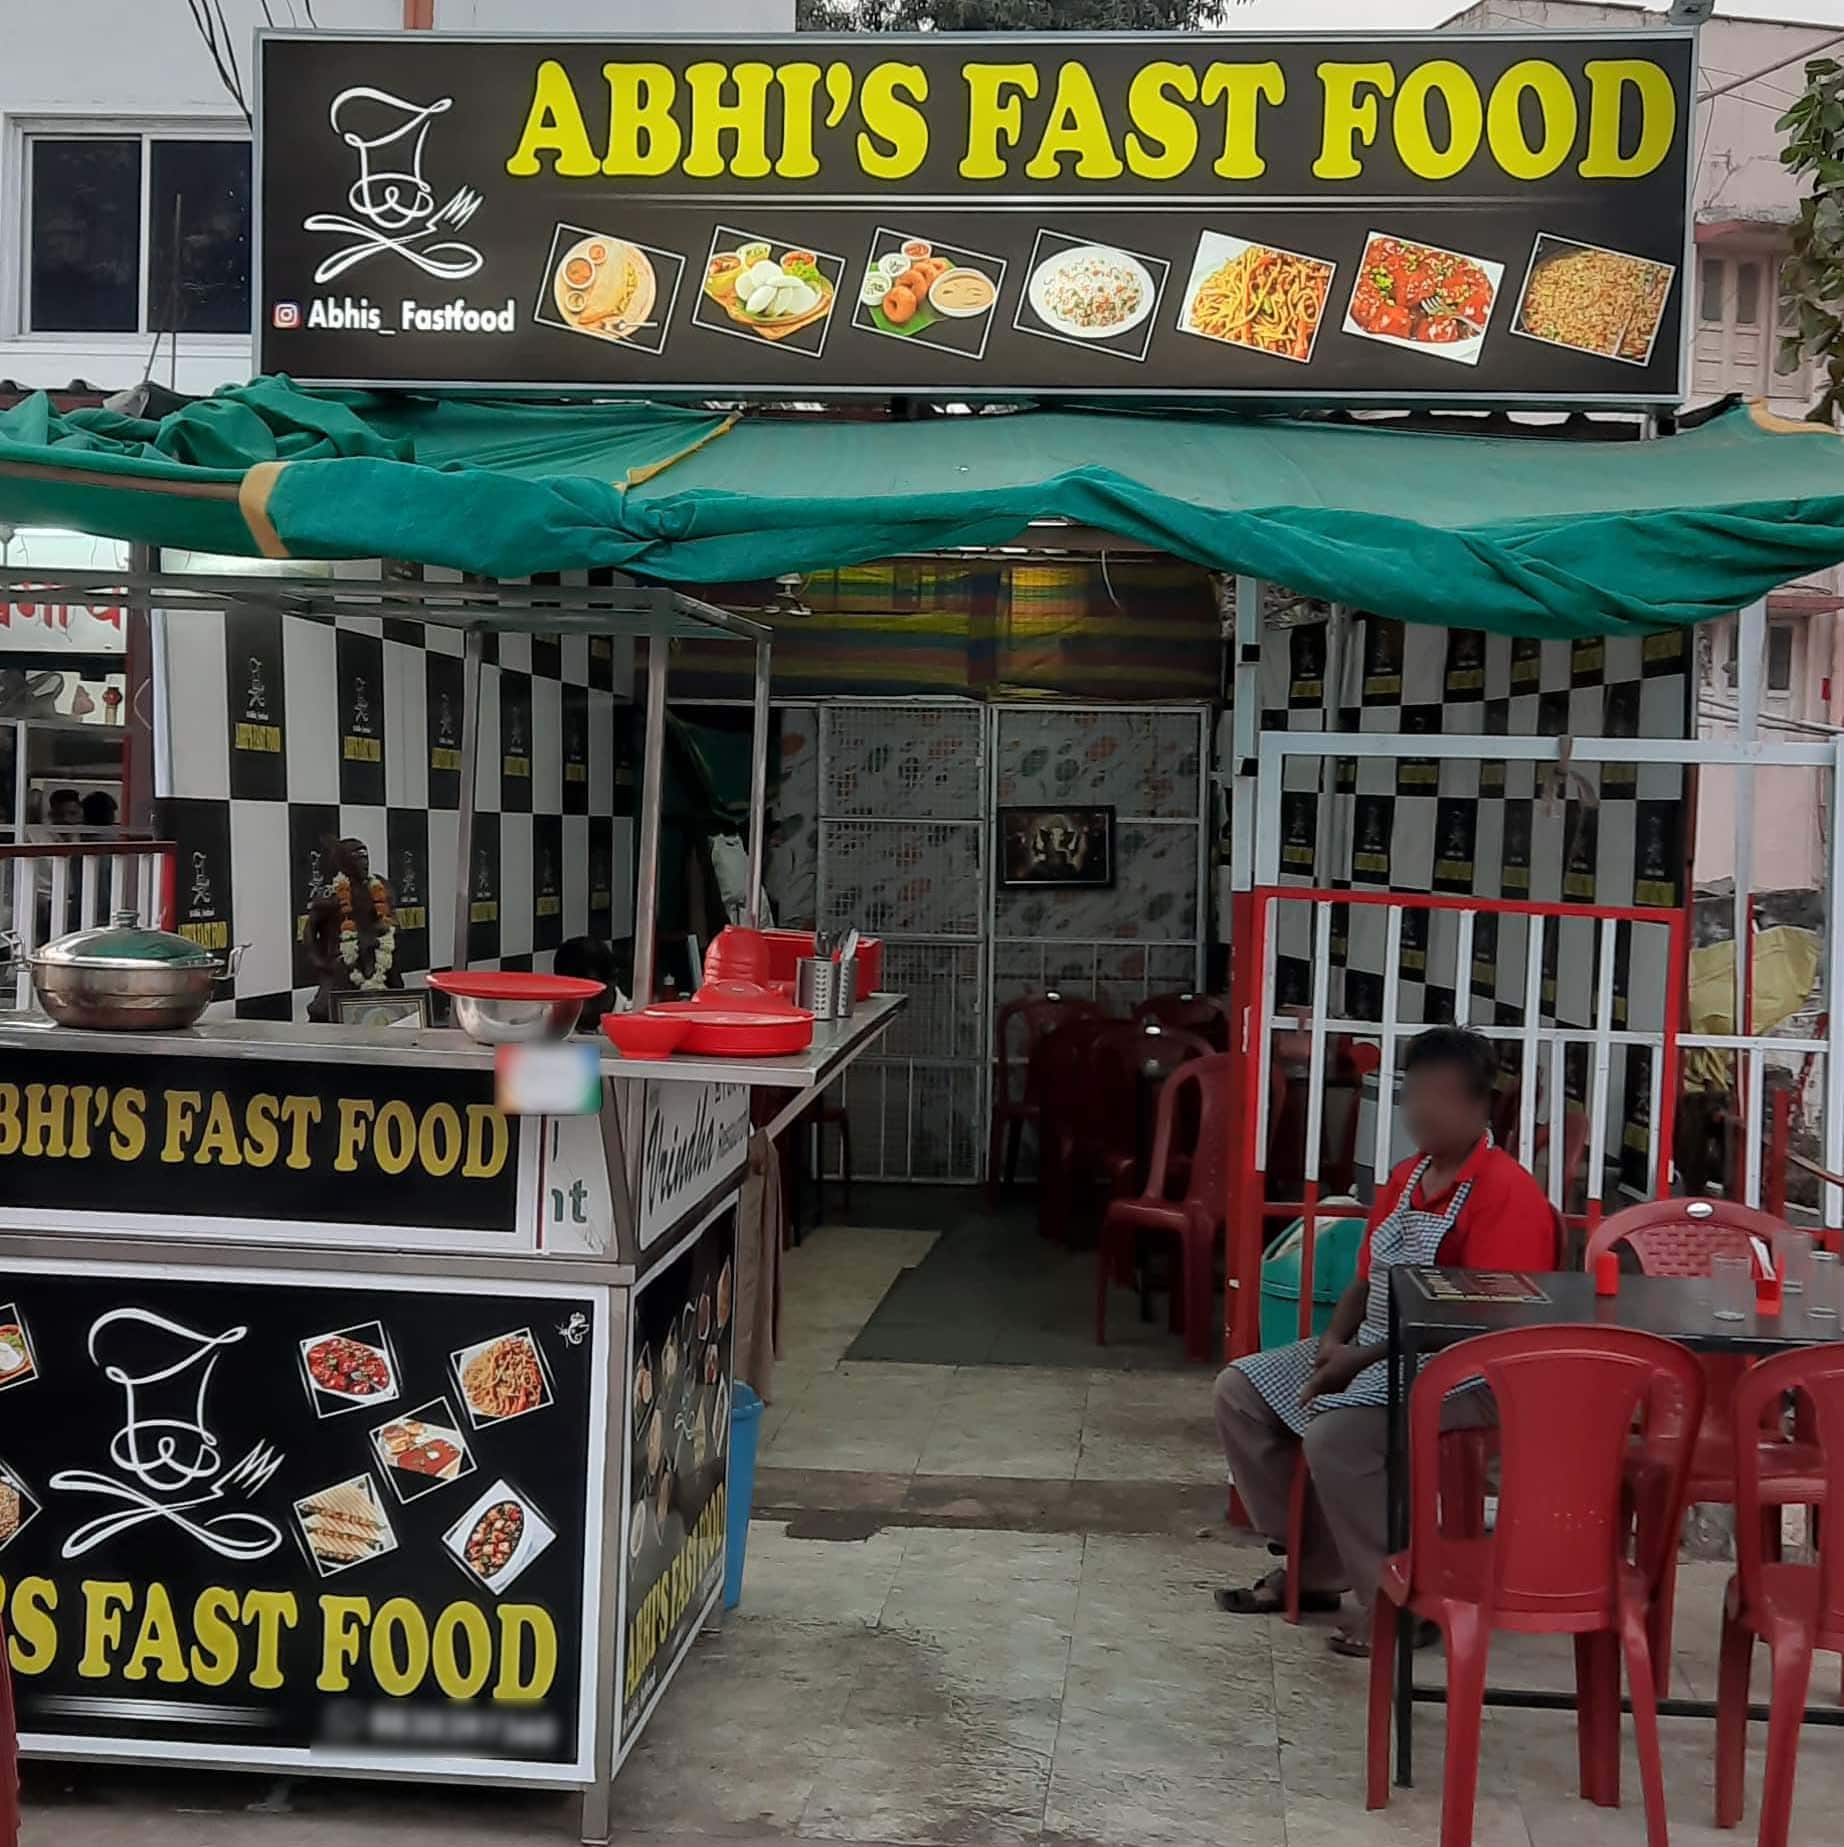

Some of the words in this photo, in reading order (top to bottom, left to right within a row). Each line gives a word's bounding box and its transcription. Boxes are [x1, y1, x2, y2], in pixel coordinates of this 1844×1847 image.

[505, 60, 929, 180] ABHI'S
[959, 60, 1286, 180] FAST
[1311, 59, 1676, 181] FOOD
[307, 296, 396, 335] Abhis_
[401, 298, 515, 332] Fastfood
[160, 1090, 321, 1170] FAST
[334, 1099, 509, 1178] FOOD
[78, 1581, 299, 1689] FAST
[316, 1595, 558, 1705] FOOD
